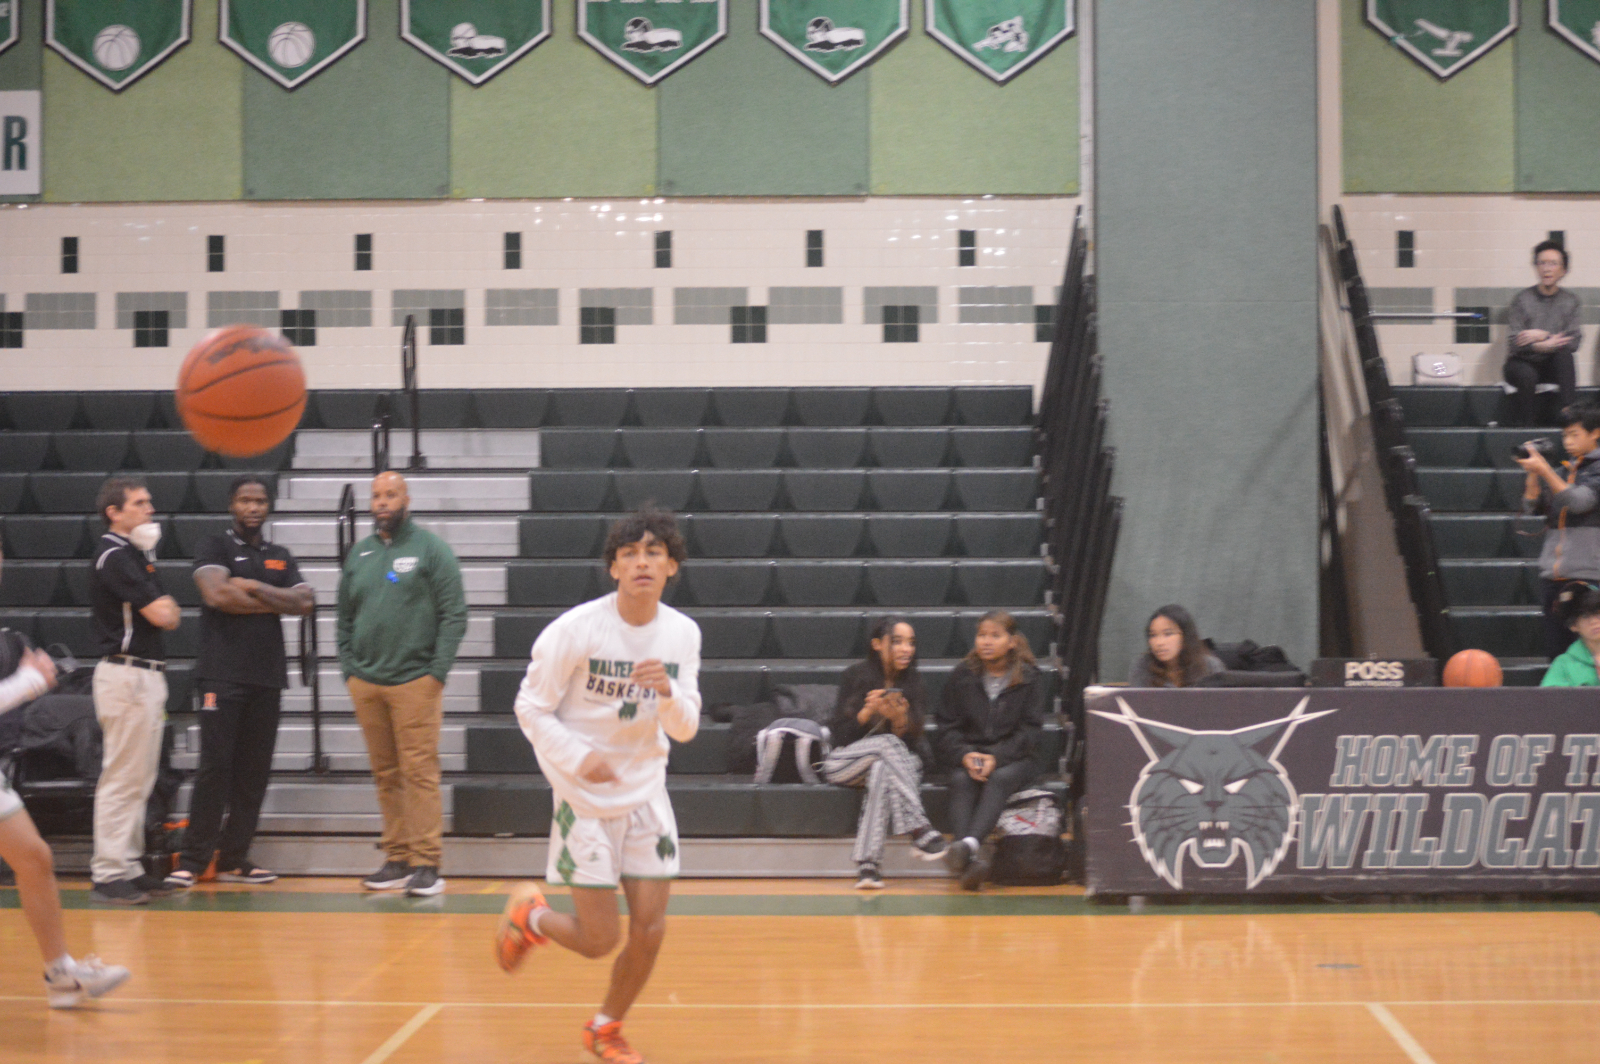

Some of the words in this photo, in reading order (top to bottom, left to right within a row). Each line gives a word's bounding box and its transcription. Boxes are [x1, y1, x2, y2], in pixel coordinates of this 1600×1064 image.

[1345, 661, 1404, 680] POSS
[1329, 734, 1480, 787] HOME
[1485, 734, 1556, 787] OF
[1562, 734, 1600, 787] T
